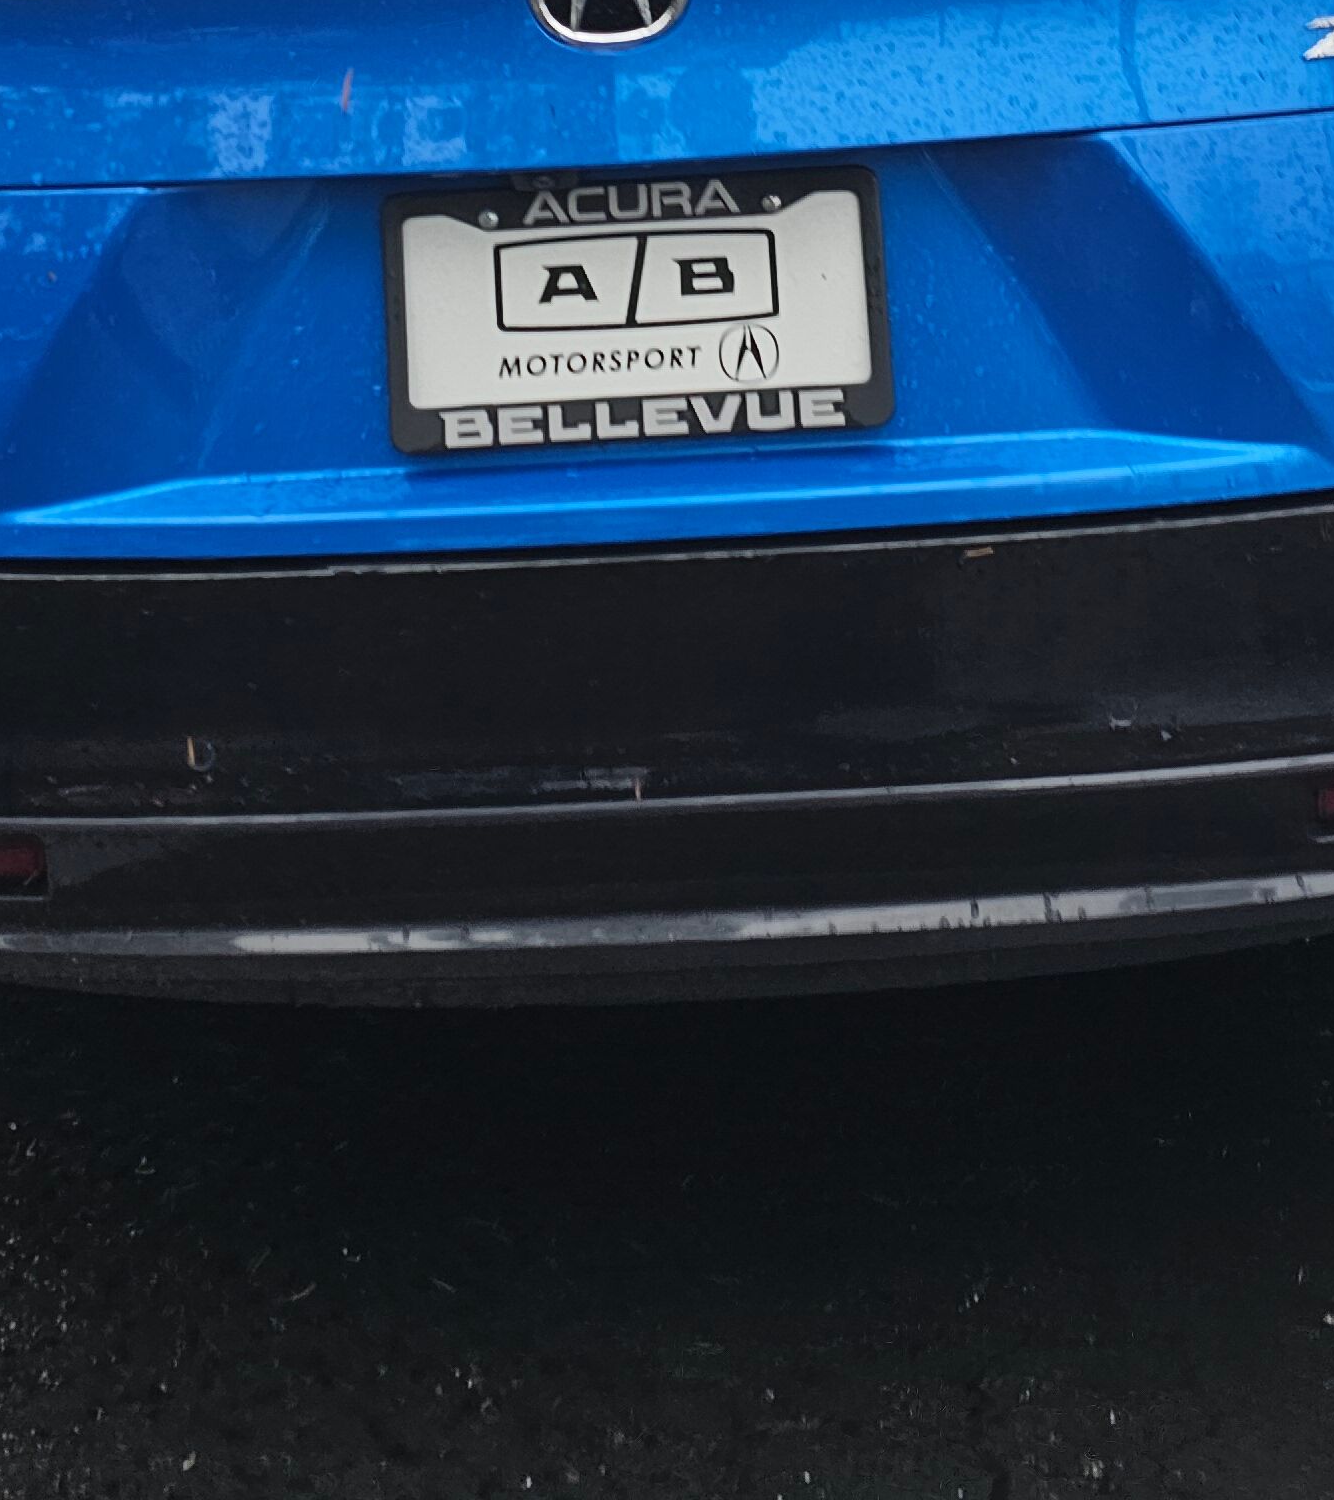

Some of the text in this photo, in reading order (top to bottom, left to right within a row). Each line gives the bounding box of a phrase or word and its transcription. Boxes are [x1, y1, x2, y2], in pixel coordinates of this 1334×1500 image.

[522, 179, 741, 226] ACURA
[498, 345, 702, 379] MOTORSPORT
[439, 388, 847, 450] BELLEVUE
